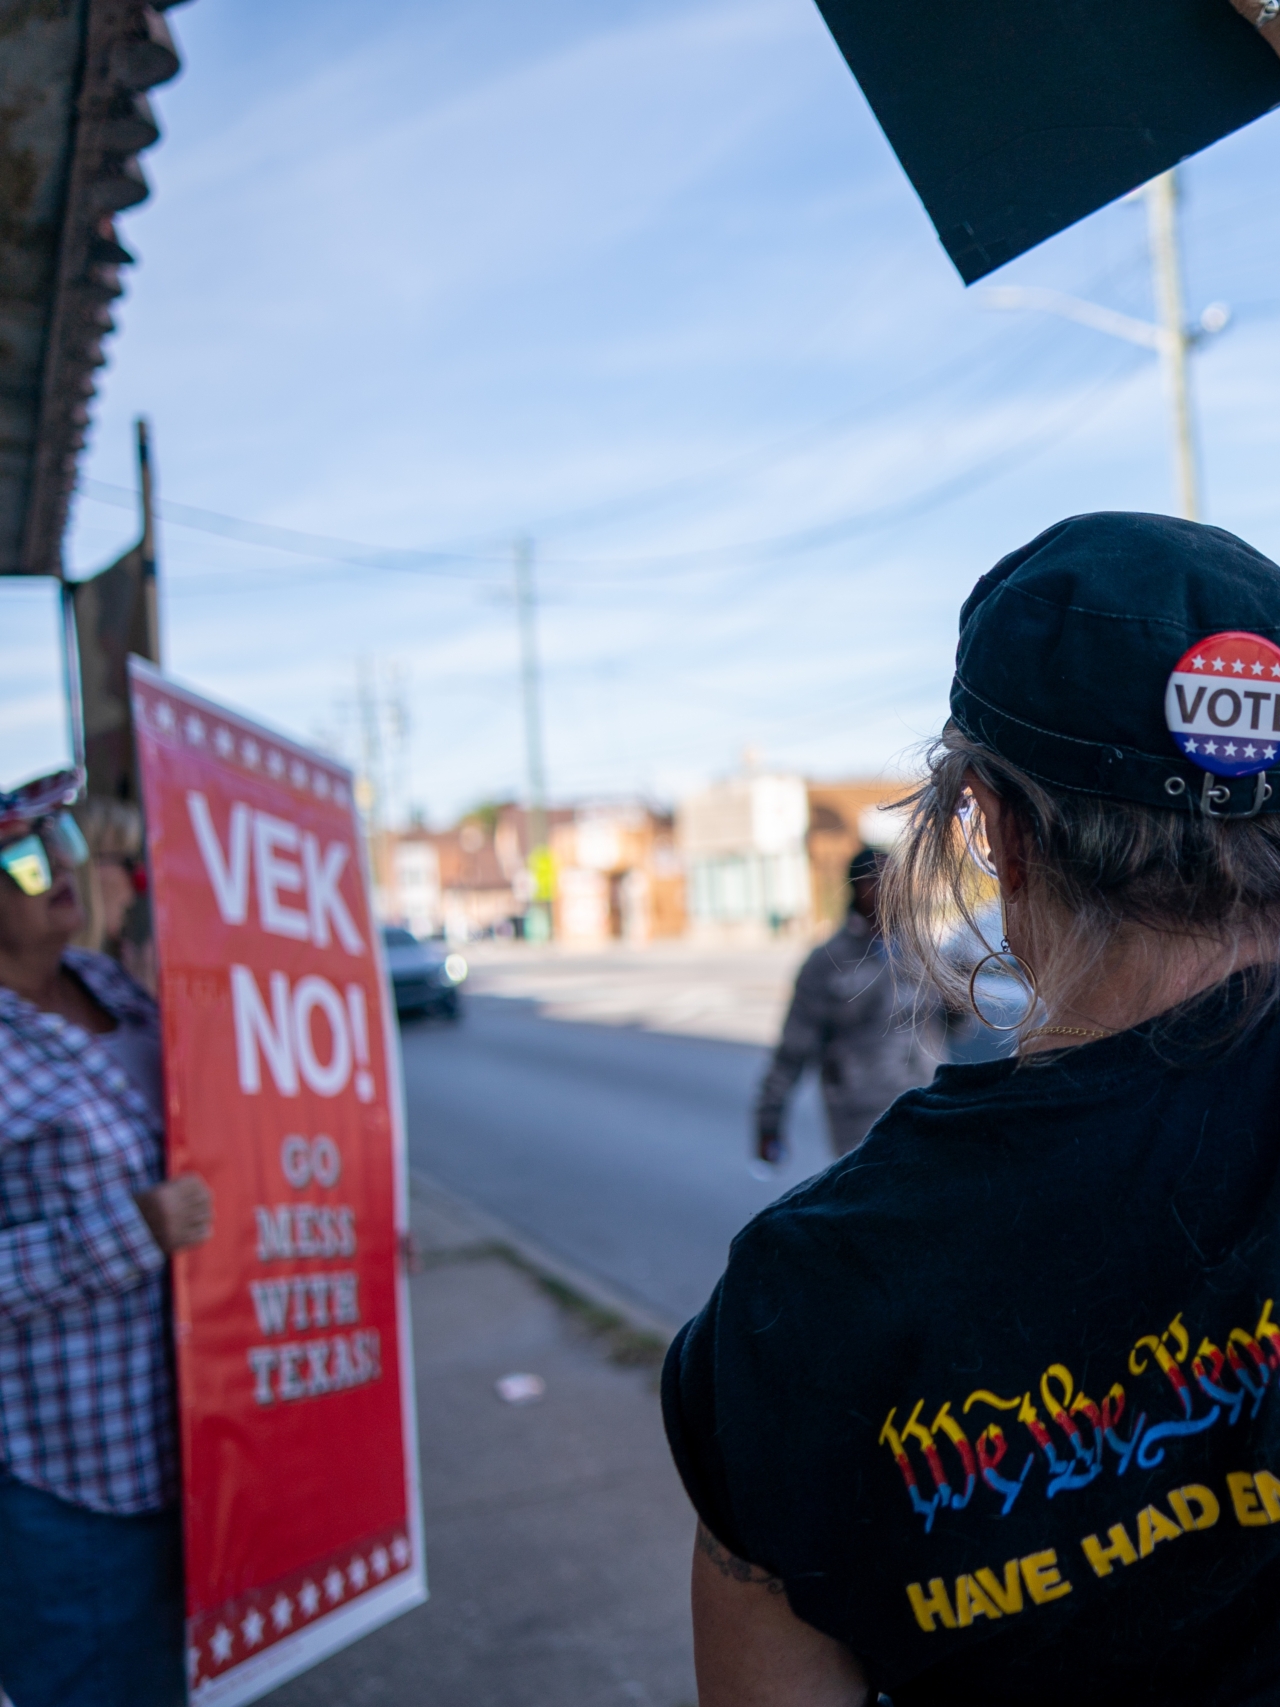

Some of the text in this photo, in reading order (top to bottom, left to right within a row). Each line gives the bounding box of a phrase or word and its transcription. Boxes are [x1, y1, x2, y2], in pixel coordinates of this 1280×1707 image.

[187, 789, 366, 957] VEK
[230, 963, 376, 1102] NO!
[280, 1133, 342, 1190] GO
[254, 1203, 356, 1264] MESS
[248, 1268, 360, 1337] WITH
[880, 1397, 1034, 1533] We
[906, 1549, 1073, 1631] HAVE
[1081, 1484, 1220, 1577] HAD
